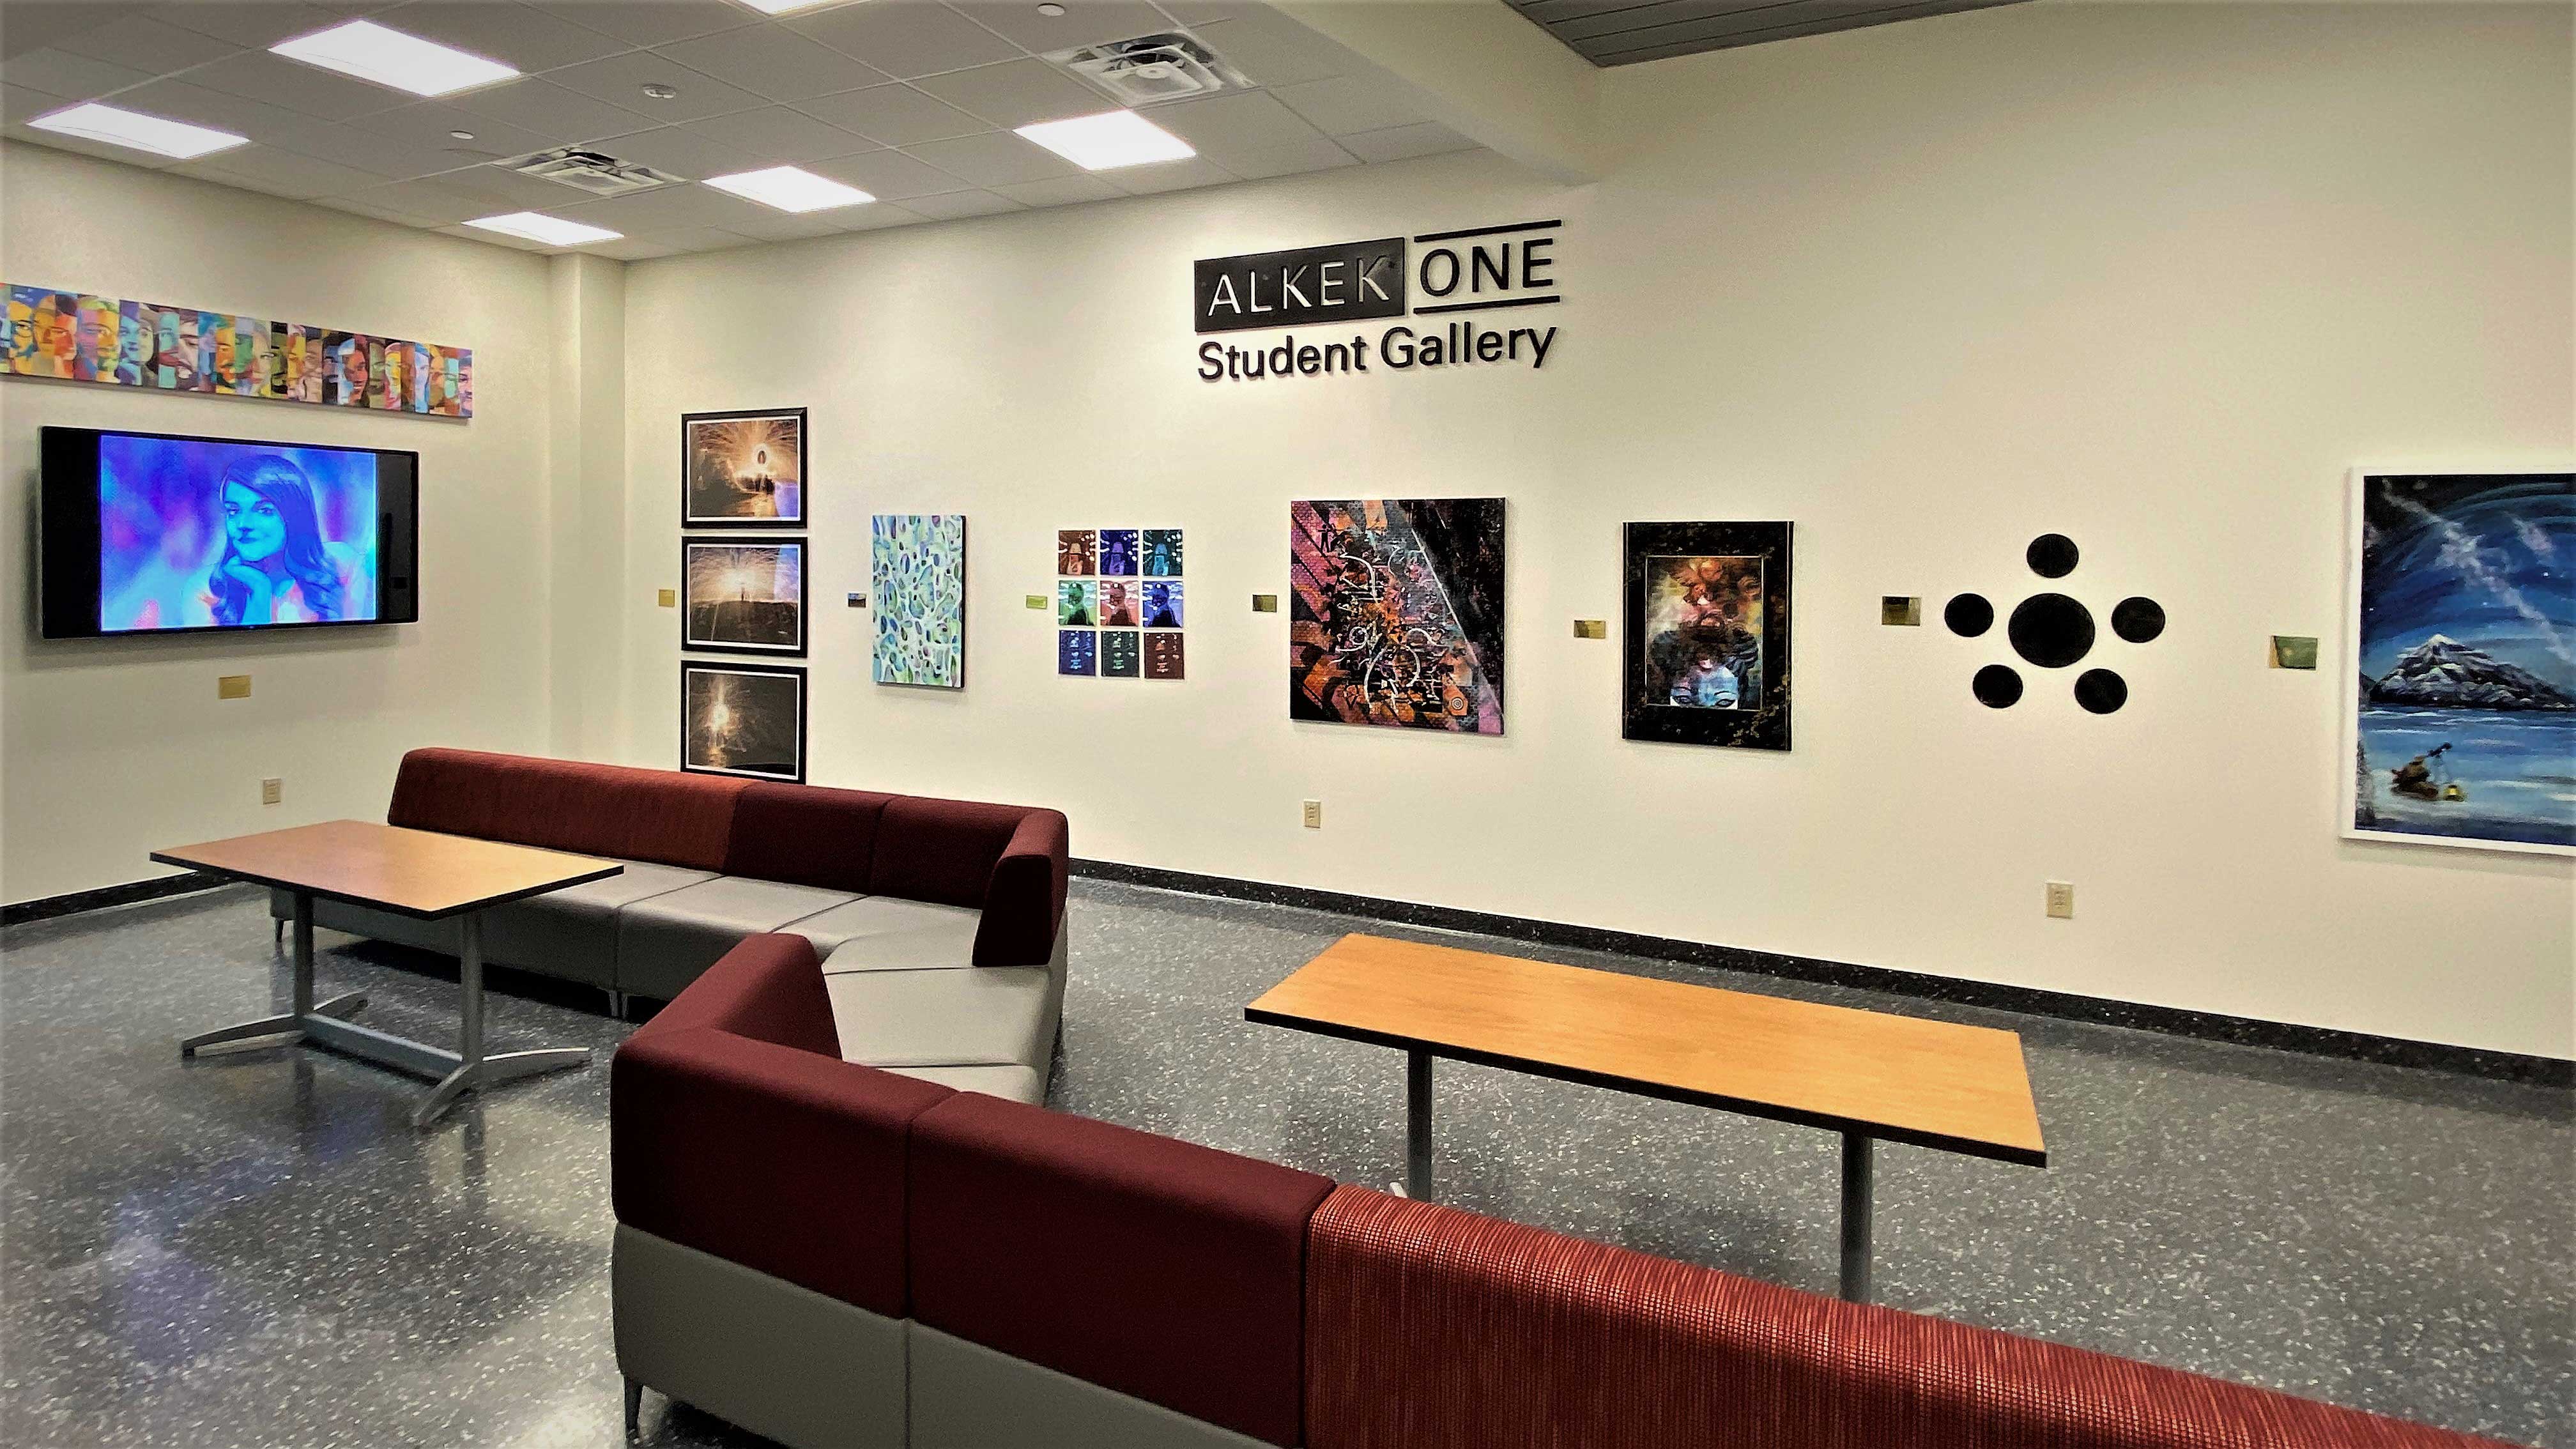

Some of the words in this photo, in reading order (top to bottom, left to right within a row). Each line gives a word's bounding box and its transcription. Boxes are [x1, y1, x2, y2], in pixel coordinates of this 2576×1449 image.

[1207, 255, 1390, 317] ALKEK
[1419, 237, 1554, 298] ONE
[1197, 334, 1367, 380] Student
[1380, 321, 1557, 369] Gallery
